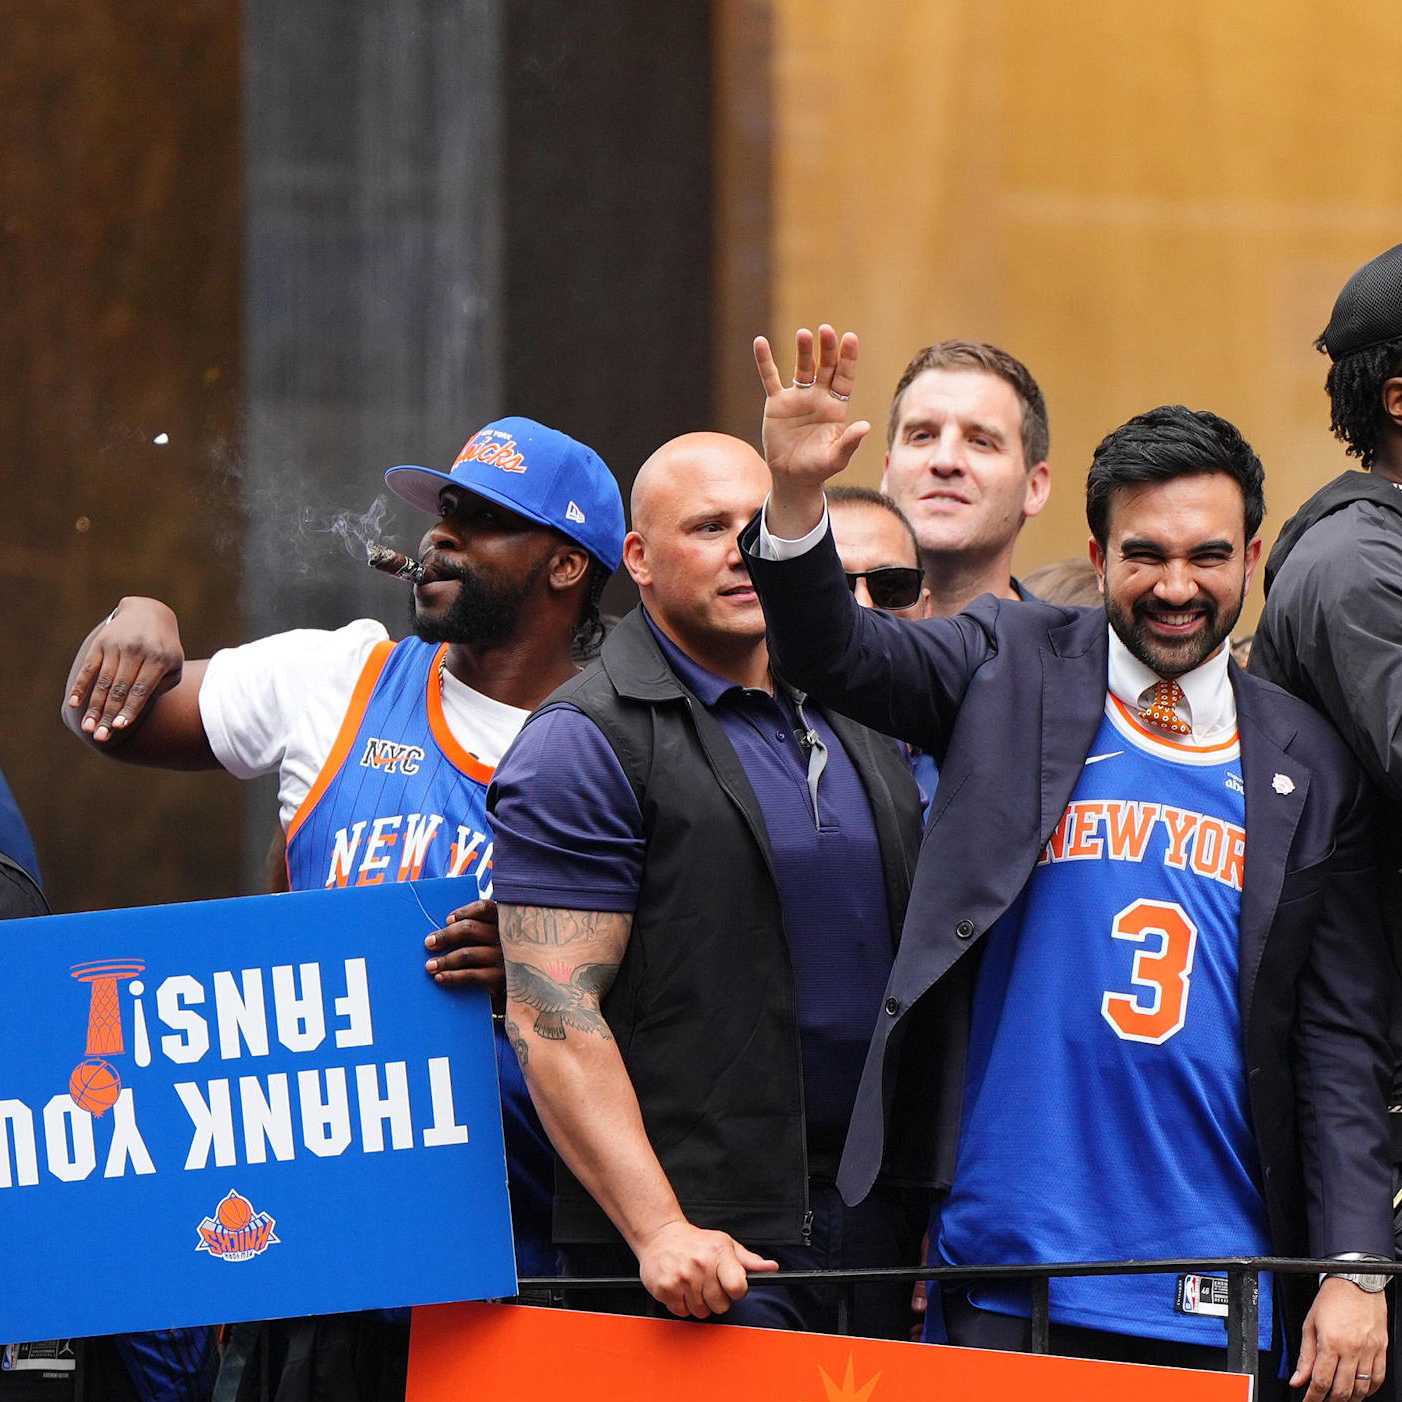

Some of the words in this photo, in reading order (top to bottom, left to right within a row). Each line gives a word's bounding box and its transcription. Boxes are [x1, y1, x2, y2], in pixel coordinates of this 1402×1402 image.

[360, 737, 425, 776] NYC
[326, 813, 444, 889] NEW
[446, 824, 494, 900] YO
[1036, 800, 1160, 866] NEW
[1161, 804, 1246, 892] YOR
[130, 957, 374, 1067] FANS!
[1101, 898, 1198, 1045] 3
[184, 1056, 469, 1171] THANK
[200, 1221, 274, 1255] KNICKS
